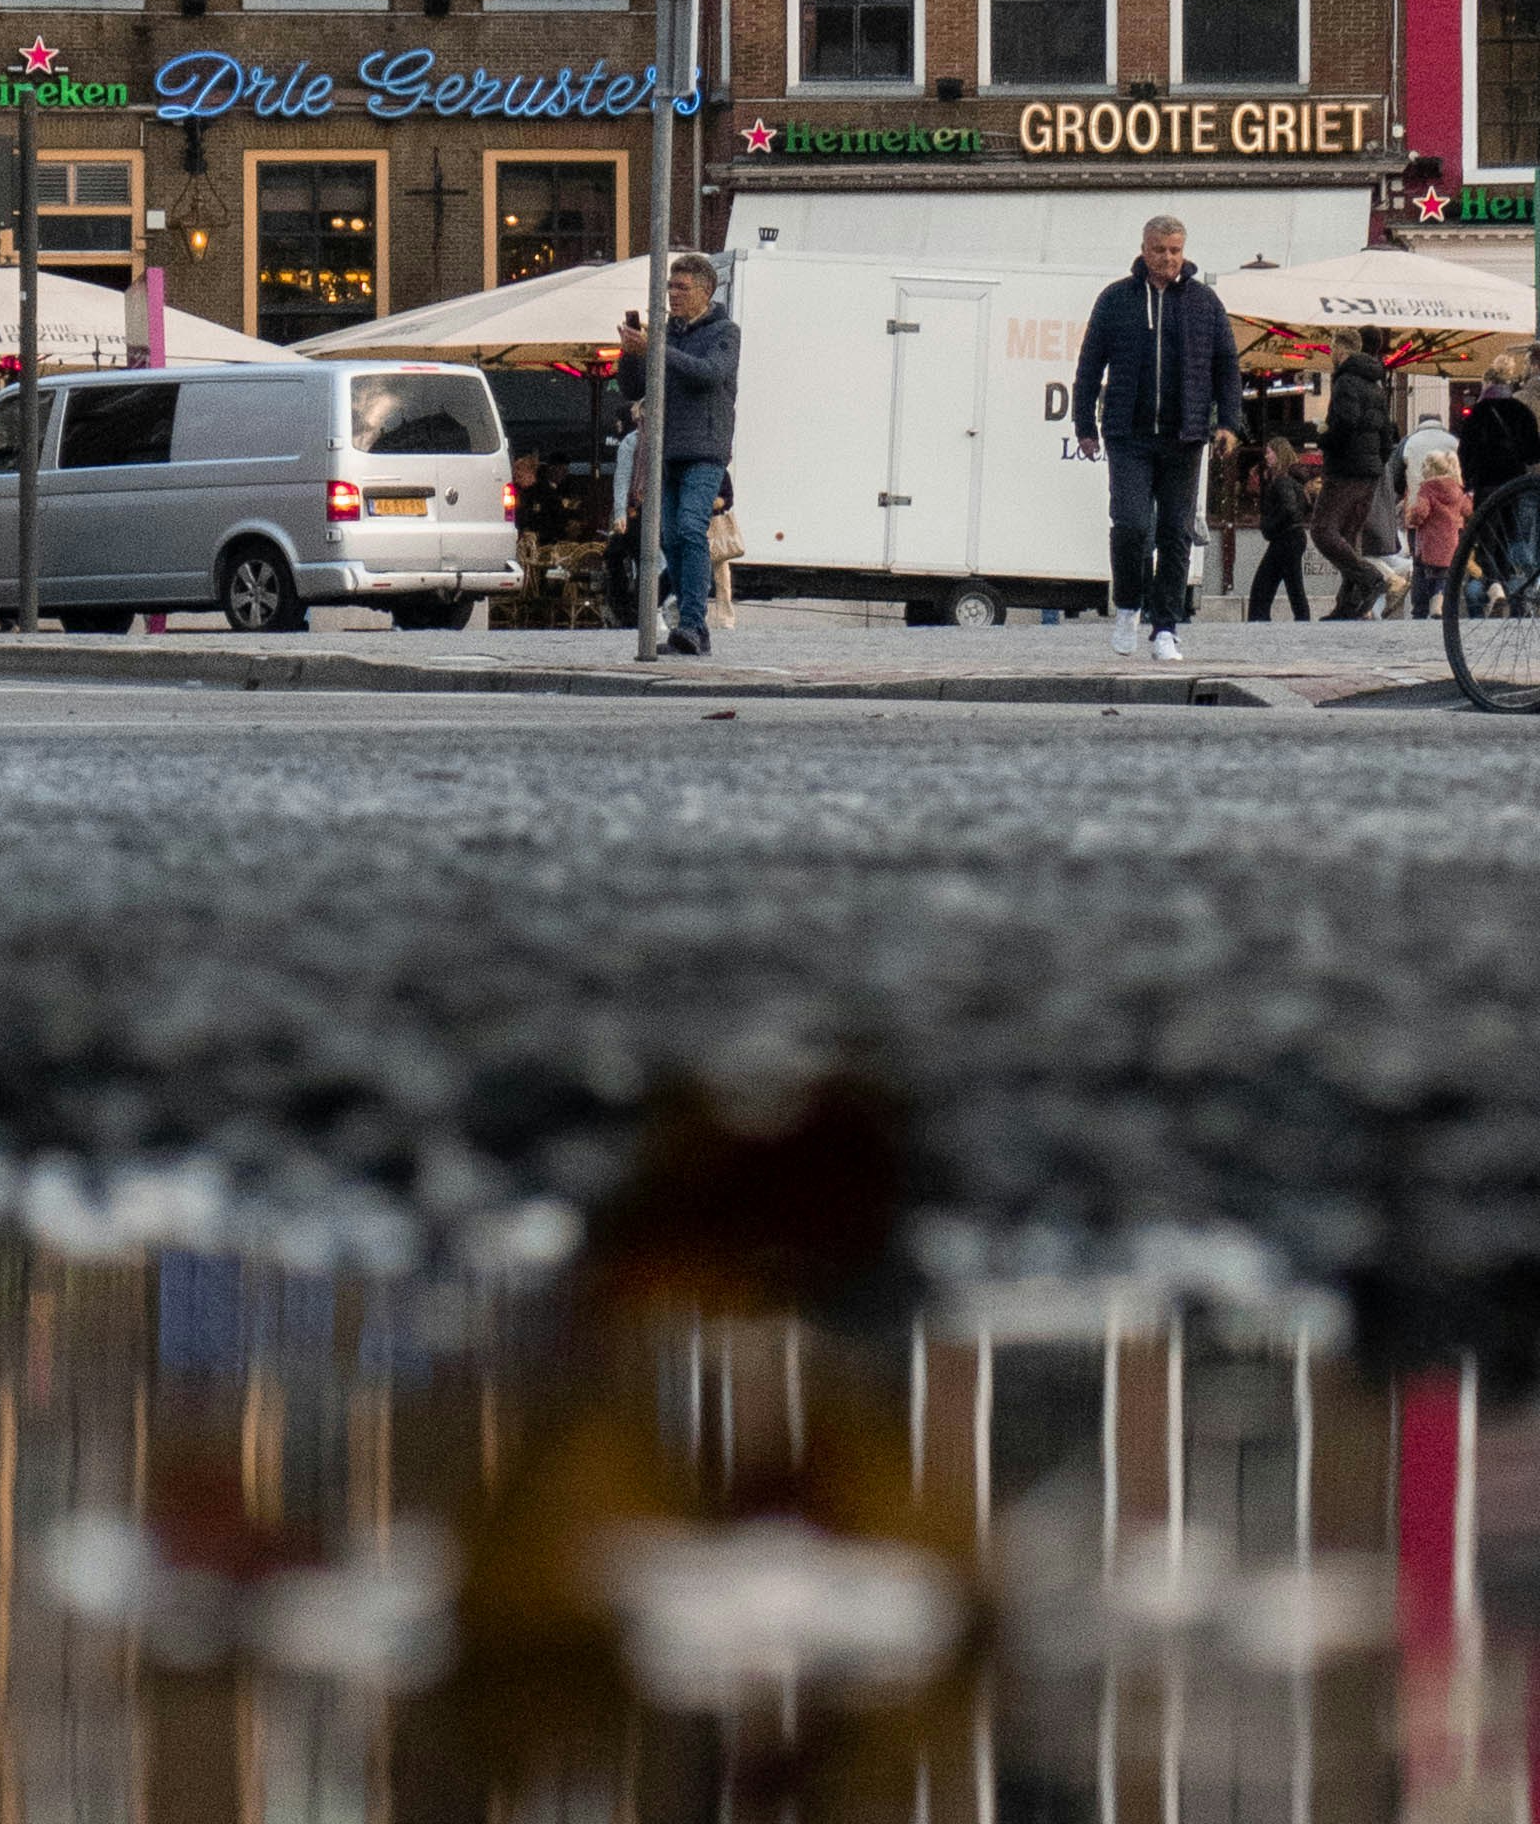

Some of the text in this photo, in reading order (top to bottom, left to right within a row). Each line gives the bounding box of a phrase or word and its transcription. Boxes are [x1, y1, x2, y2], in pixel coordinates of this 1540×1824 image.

[156, 49, 336, 119] Drie
[784, 120, 983, 154] Heineken
[1019, 101, 1370, 154] GROOTE GRIET
[1460, 186, 1535, 220] Hei
